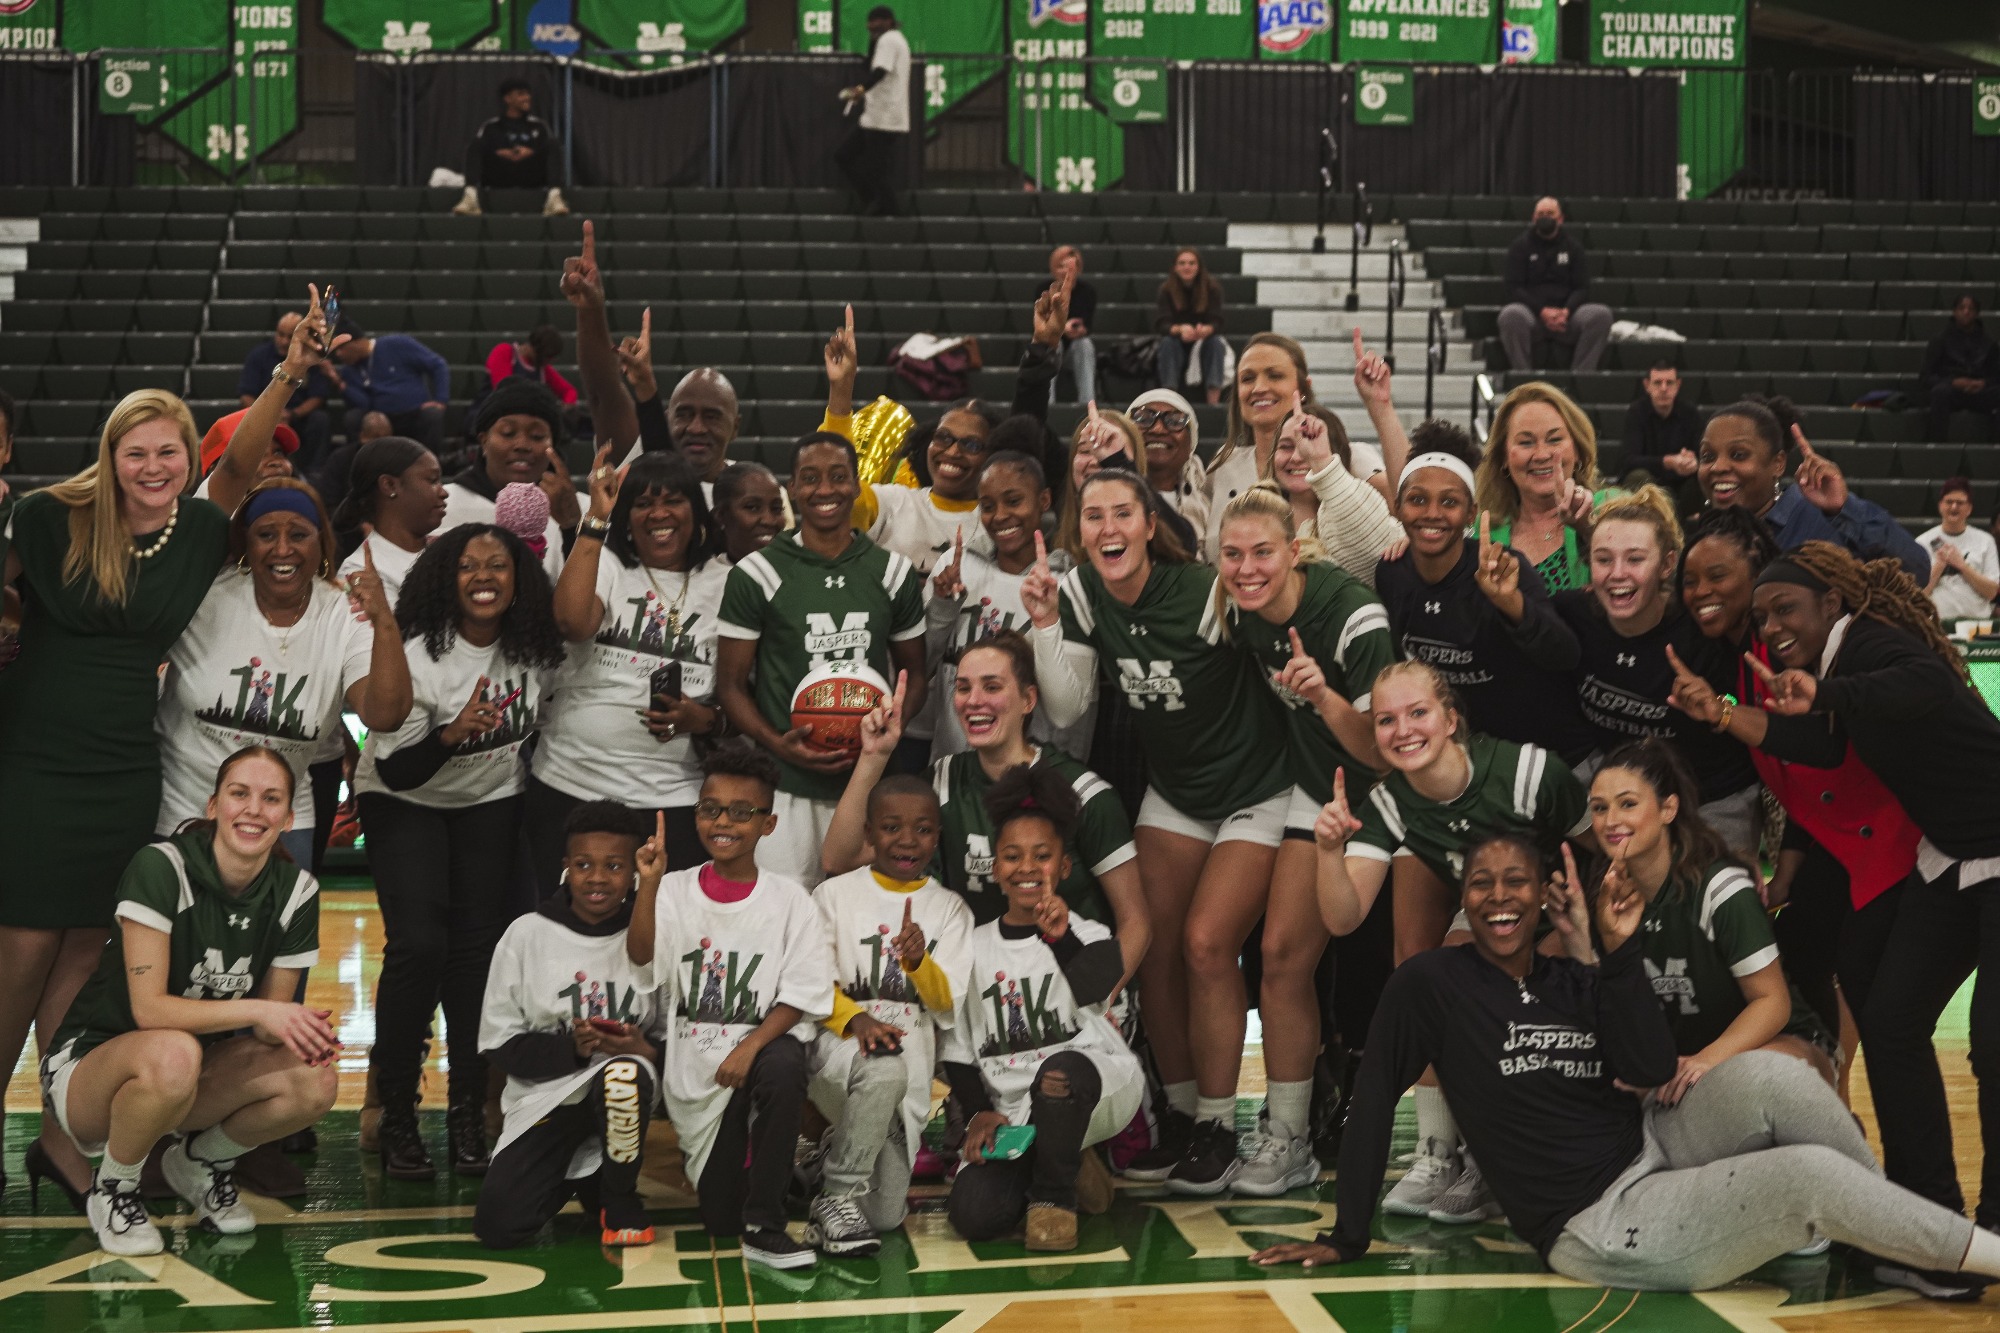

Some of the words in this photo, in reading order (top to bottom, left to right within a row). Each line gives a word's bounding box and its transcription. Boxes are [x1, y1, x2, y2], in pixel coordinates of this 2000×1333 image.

[1104, 19, 1144, 39] 2012
[1350, 19, 1389, 39] 1999
[1400, 22, 1437, 42] 2021
[1600, 12, 1736, 35] TOURNAMENT
[1602, 34, 1734, 60] CHAMPIONS
[105, 58, 151, 72] Section
[1113, 67, 1158, 81] Section
[1360, 69, 1405, 84] Section
[812, 631, 868, 650] JASPERS
[229, 665, 309, 737] 1K
[681, 948, 765, 1022] 1K
[1503, 1020, 1597, 1052] JASPERS
[604, 1061, 641, 1164] RAVENS
